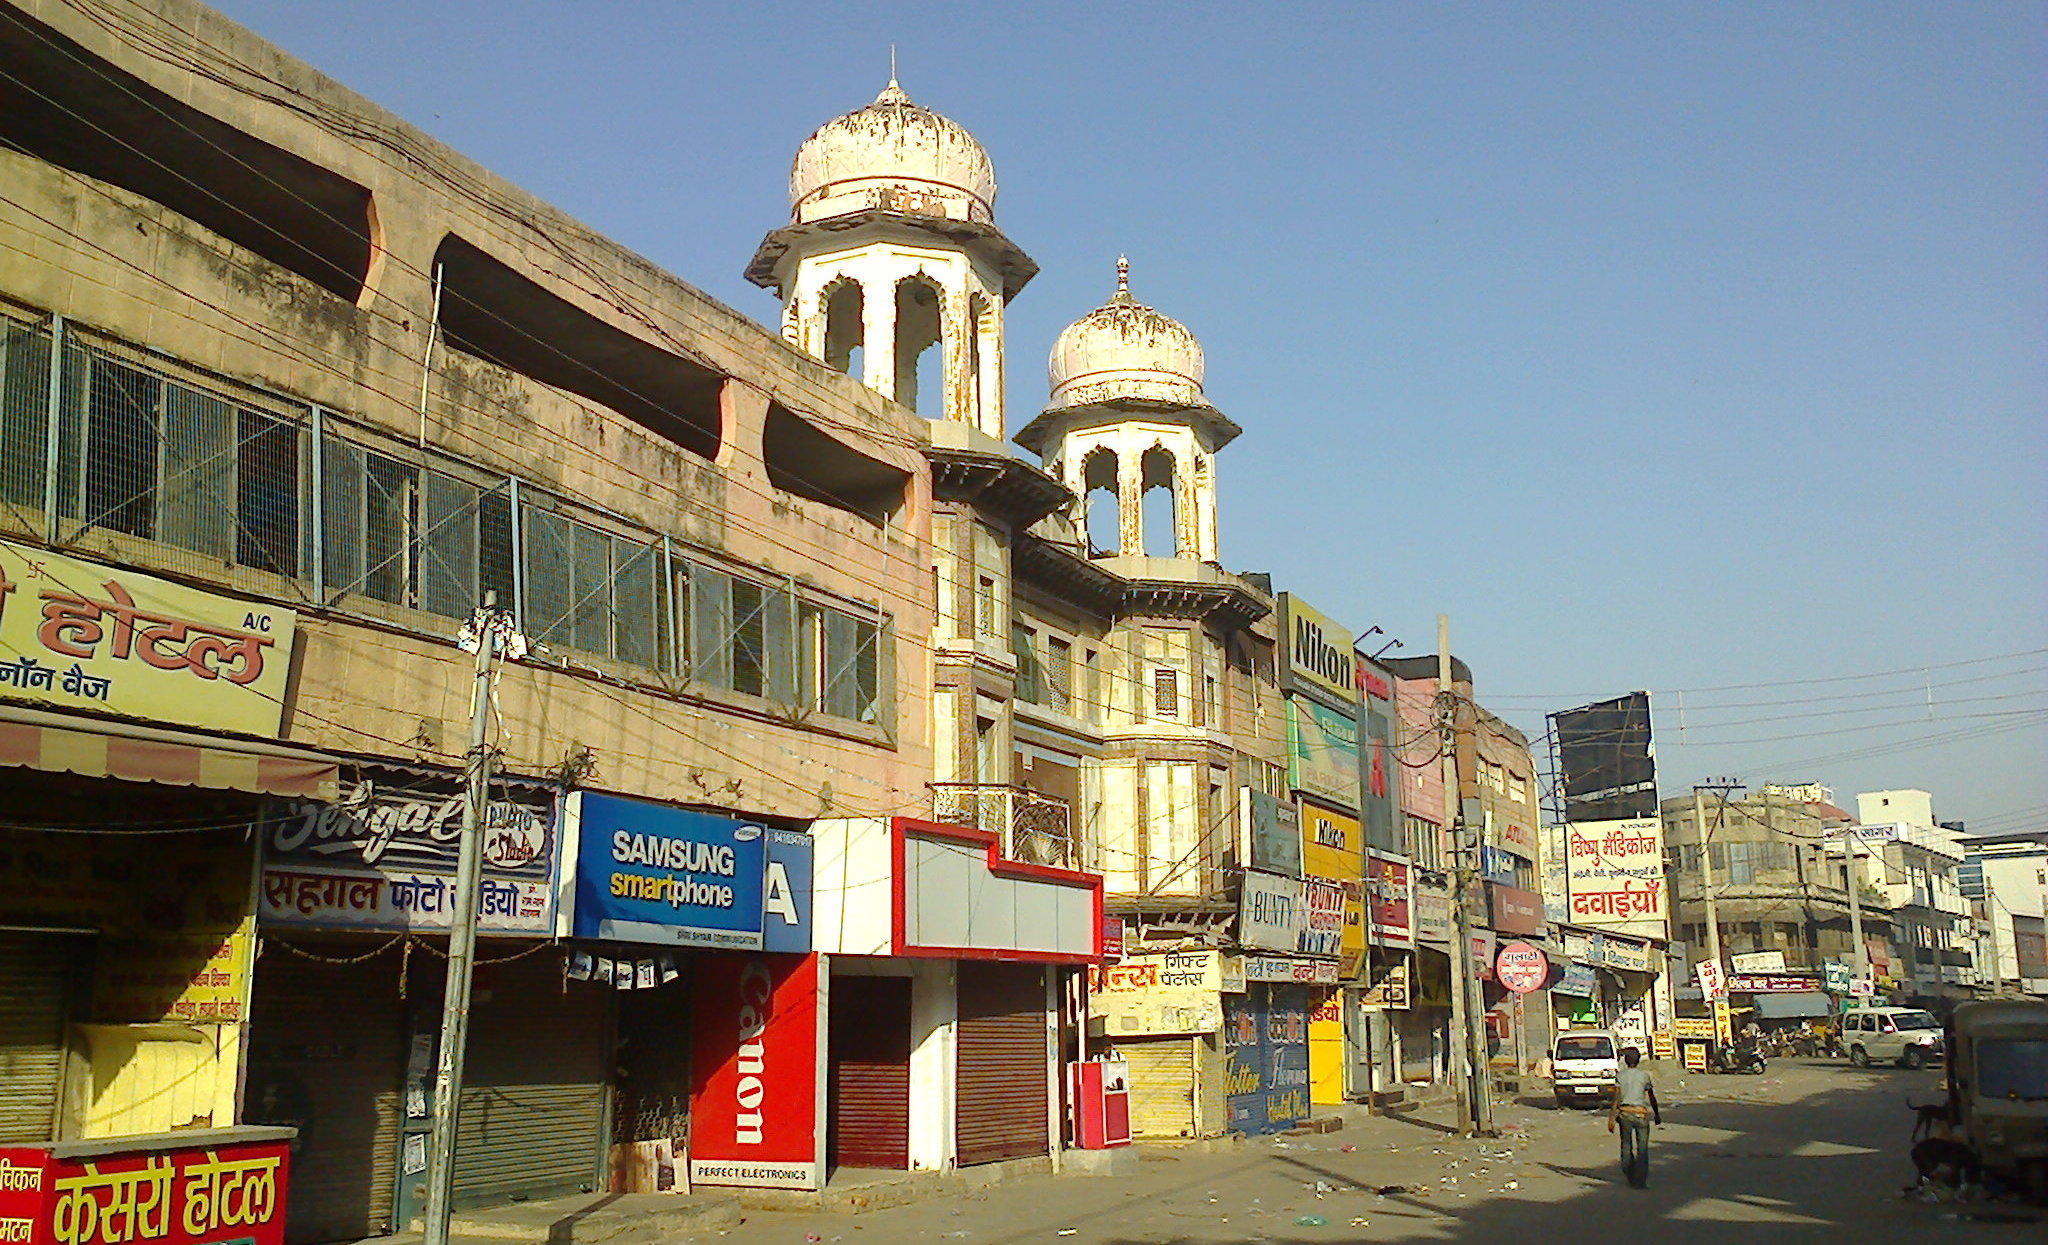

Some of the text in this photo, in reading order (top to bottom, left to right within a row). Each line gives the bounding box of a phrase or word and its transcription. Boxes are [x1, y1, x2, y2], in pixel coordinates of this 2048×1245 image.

[38, 579, 275, 685] होटल
[243, 612, 272, 632] A/C
[1295, 615, 1350, 690] Nikon
[62, 664, 111, 700] वैज
[612, 829, 735, 876] SAMSUNG
[264, 870, 384, 914] सहगल
[389, 874, 445, 914] फोटो
[610, 872, 733, 908] smartphone
[1572, 879, 1661, 918] दवाईयाँ
[736, 960, 772, 1145] Canon
[183, 1150, 281, 1236] होटल
[698, 1166, 807, 1181] PERFECT ELECTRONICS
